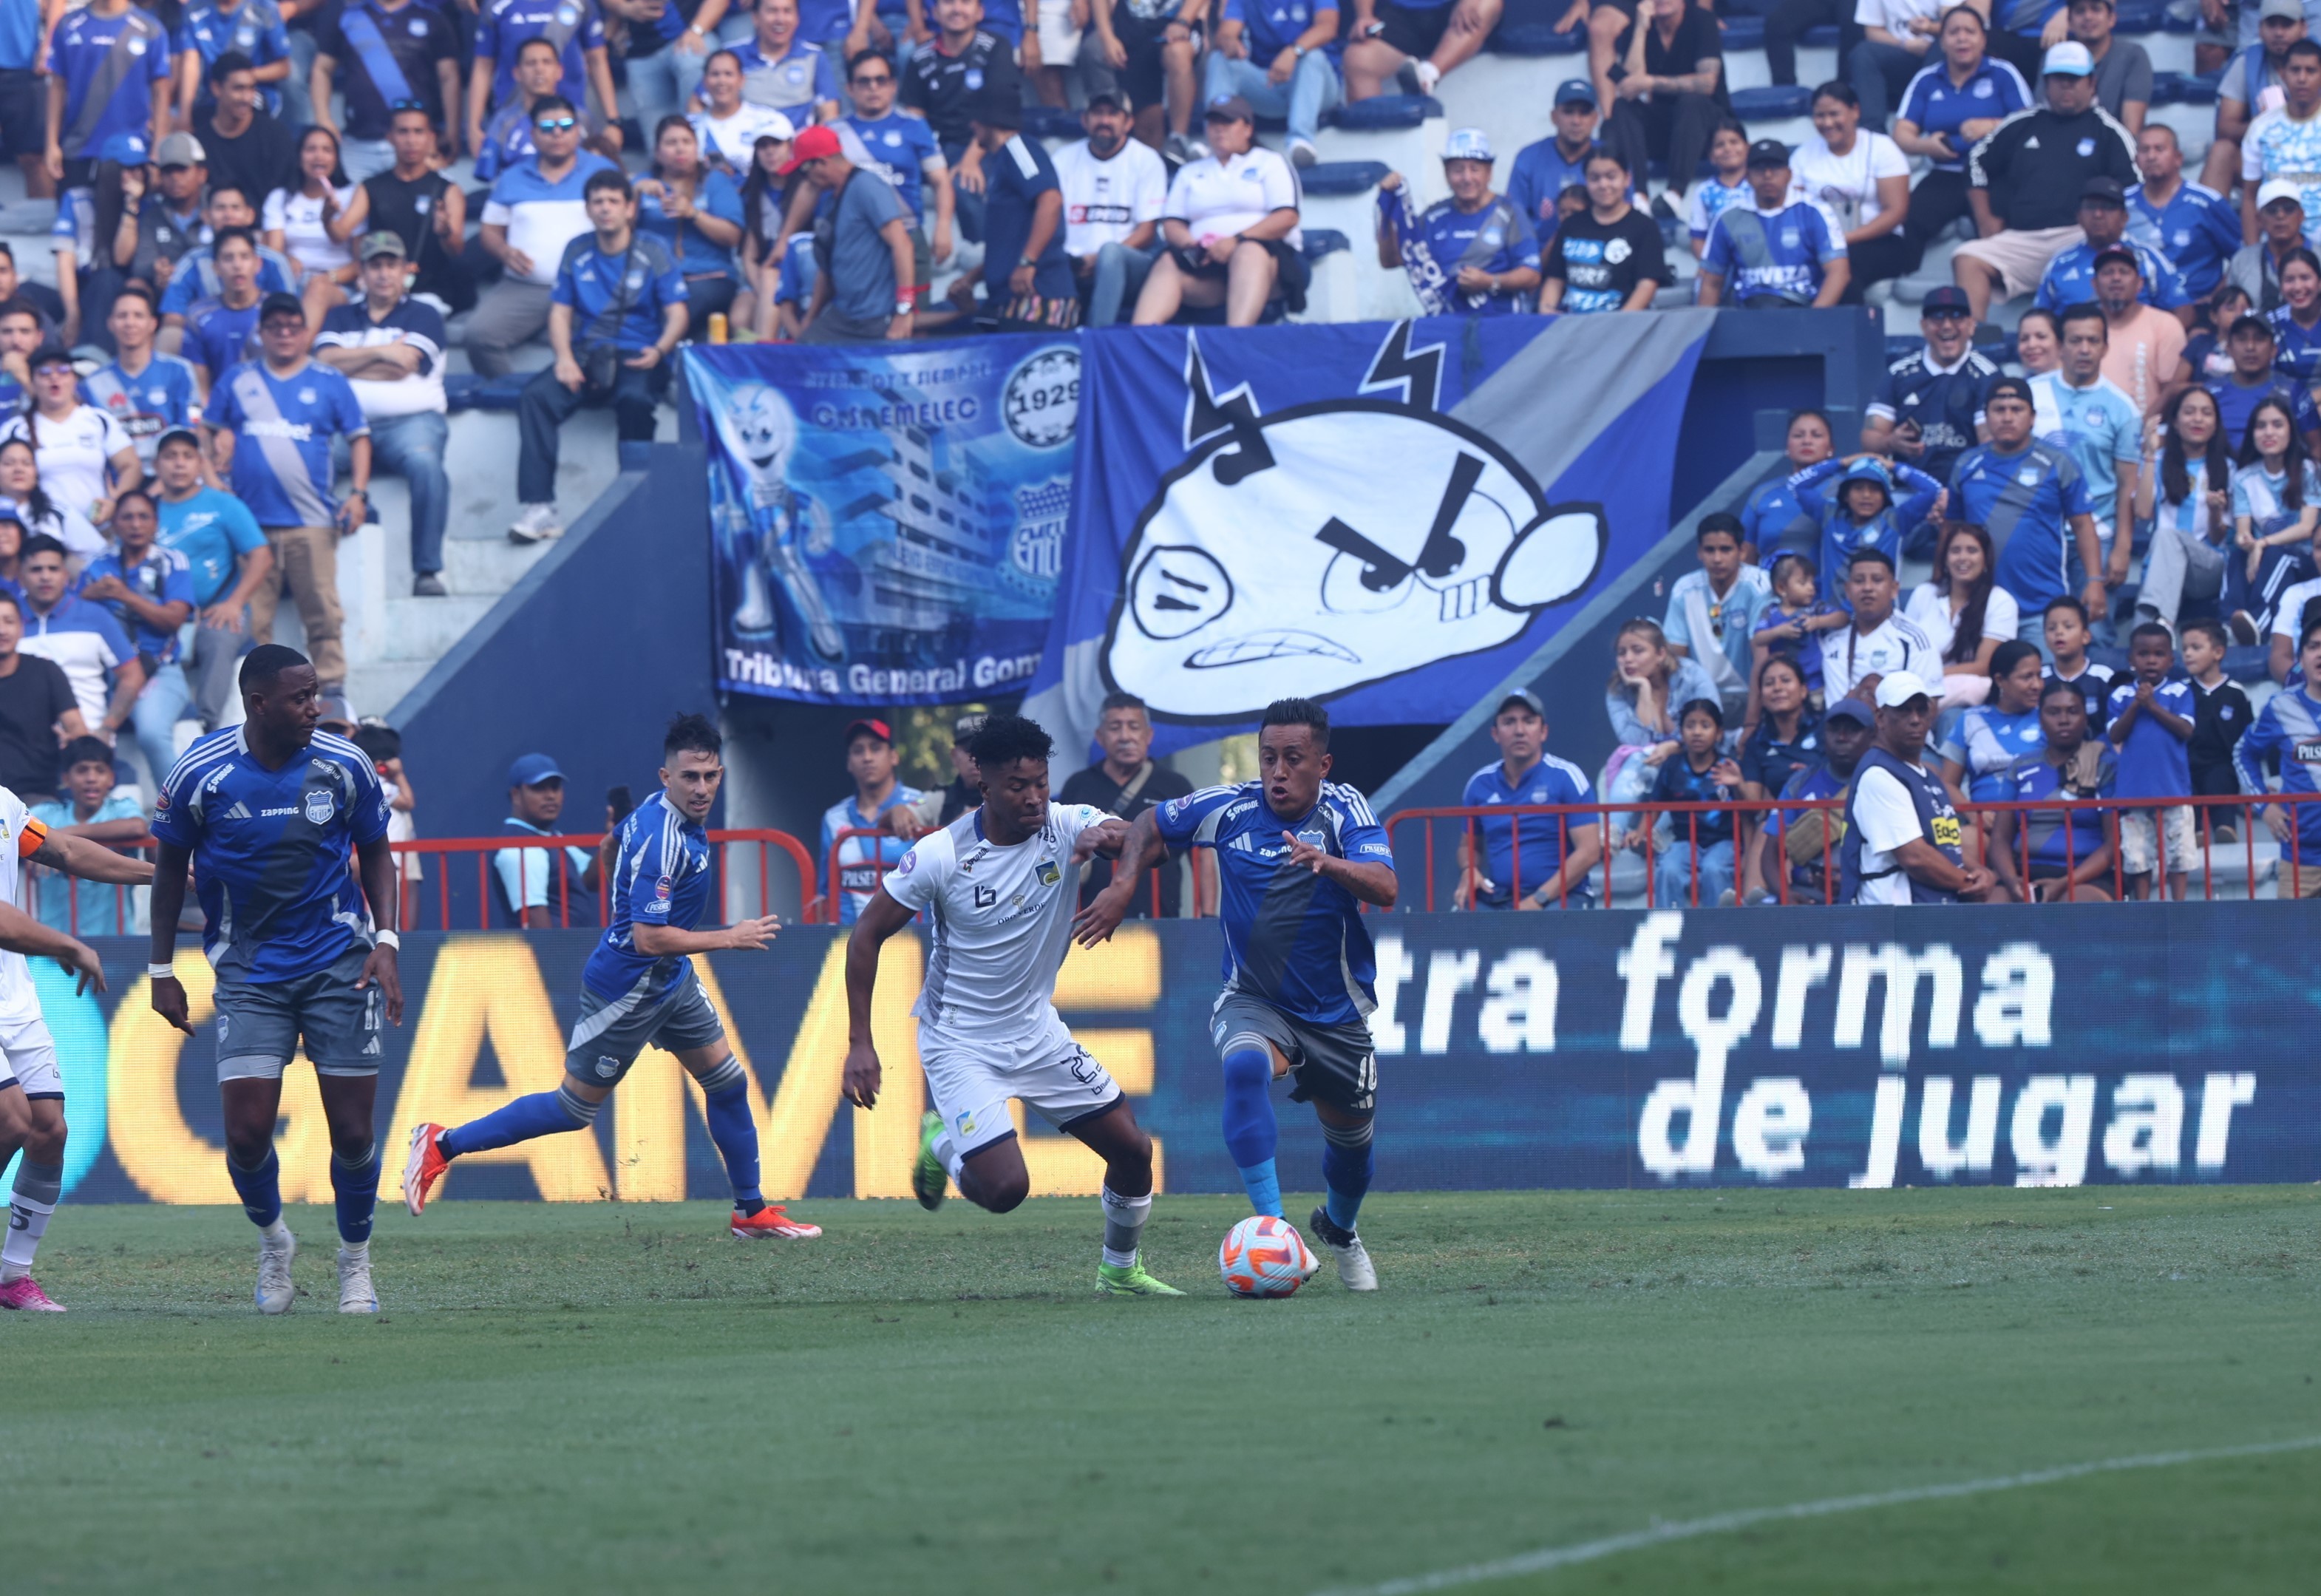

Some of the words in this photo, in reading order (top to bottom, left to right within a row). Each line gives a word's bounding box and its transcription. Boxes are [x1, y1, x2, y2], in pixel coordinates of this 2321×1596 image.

[881, 397, 979, 428] EMELEC
[1017, 379, 1081, 415] 1929
[847, 659, 965, 694] General
[211, 762, 236, 786] SPORADE
[1233, 798, 1260, 815] SPORADE
[1372, 934, 1560, 1054] tra
[1616, 910, 2055, 1051] forma
[106, 928, 1167, 1206] GAME
[1356, 1051, 1377, 1093] 10
[1637, 1036, 1812, 1178] de
[1848, 1050, 2257, 1189] jugar
